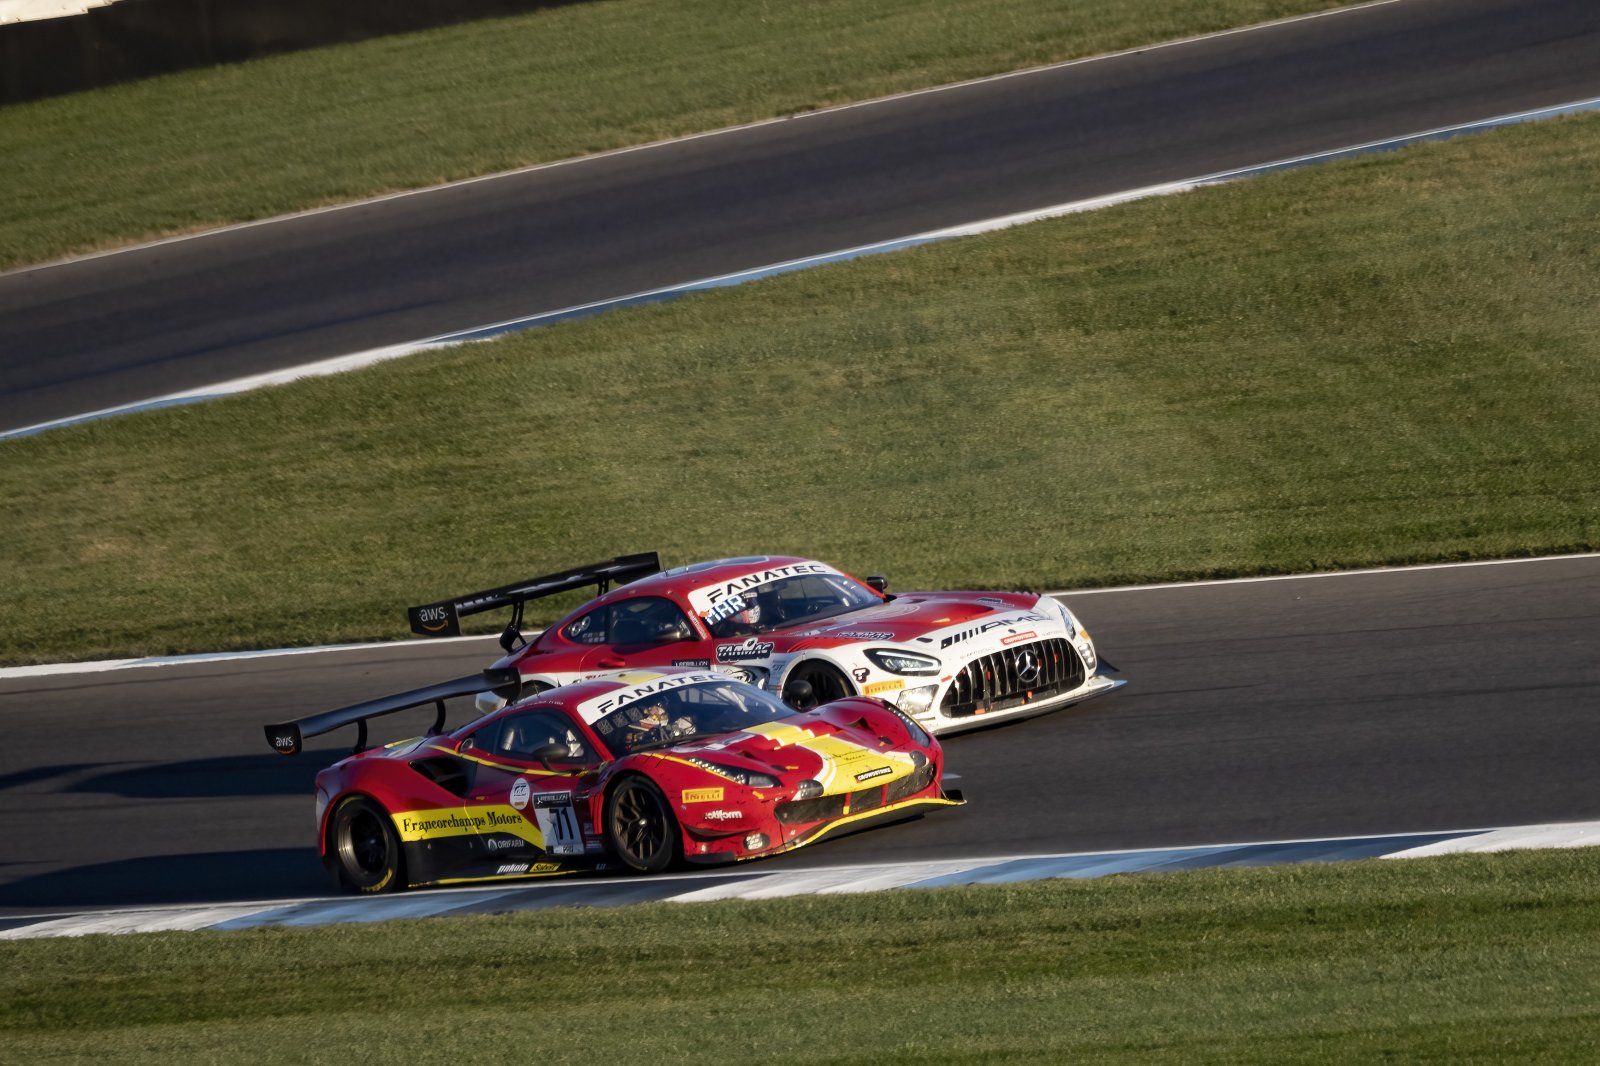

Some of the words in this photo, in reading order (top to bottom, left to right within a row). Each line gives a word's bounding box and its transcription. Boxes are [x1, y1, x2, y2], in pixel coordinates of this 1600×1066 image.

[707, 565, 826, 604] FANATEC
[419, 606, 448, 622] aws
[718, 641, 773, 660] TARMAC
[597, 674, 727, 714] FANATEC
[276, 736, 294, 748] aws
[684, 790, 721, 801] PIRELLI
[402, 813, 486, 833] Francorchamps
[487, 811, 523, 828] Motors
